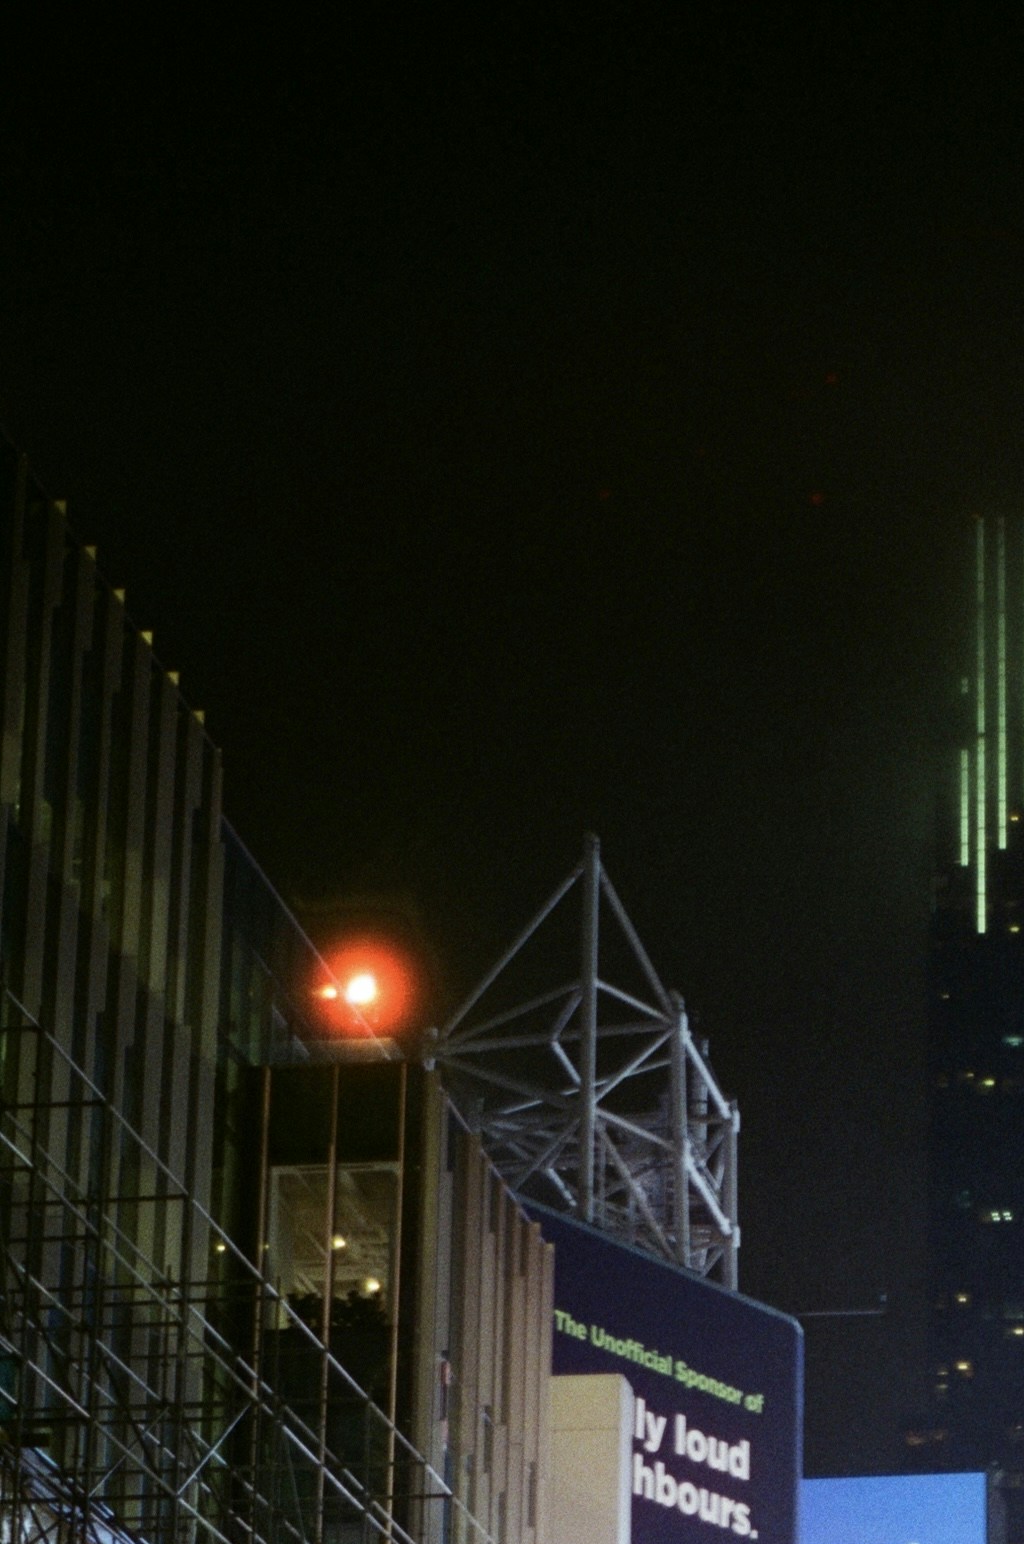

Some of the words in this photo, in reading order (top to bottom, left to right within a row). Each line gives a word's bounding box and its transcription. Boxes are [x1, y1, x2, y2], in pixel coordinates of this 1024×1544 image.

[554, 1309, 587, 1341] The
[590, 1325, 673, 1377] Unofficial
[674, 1360, 743, 1405] Sponsor
[743, 1394, 765, 1414] of
[634, 1397, 667, 1453] ly
[675, 1413, 750, 1481] loud
[632, 1452, 759, 1540] hbours.
